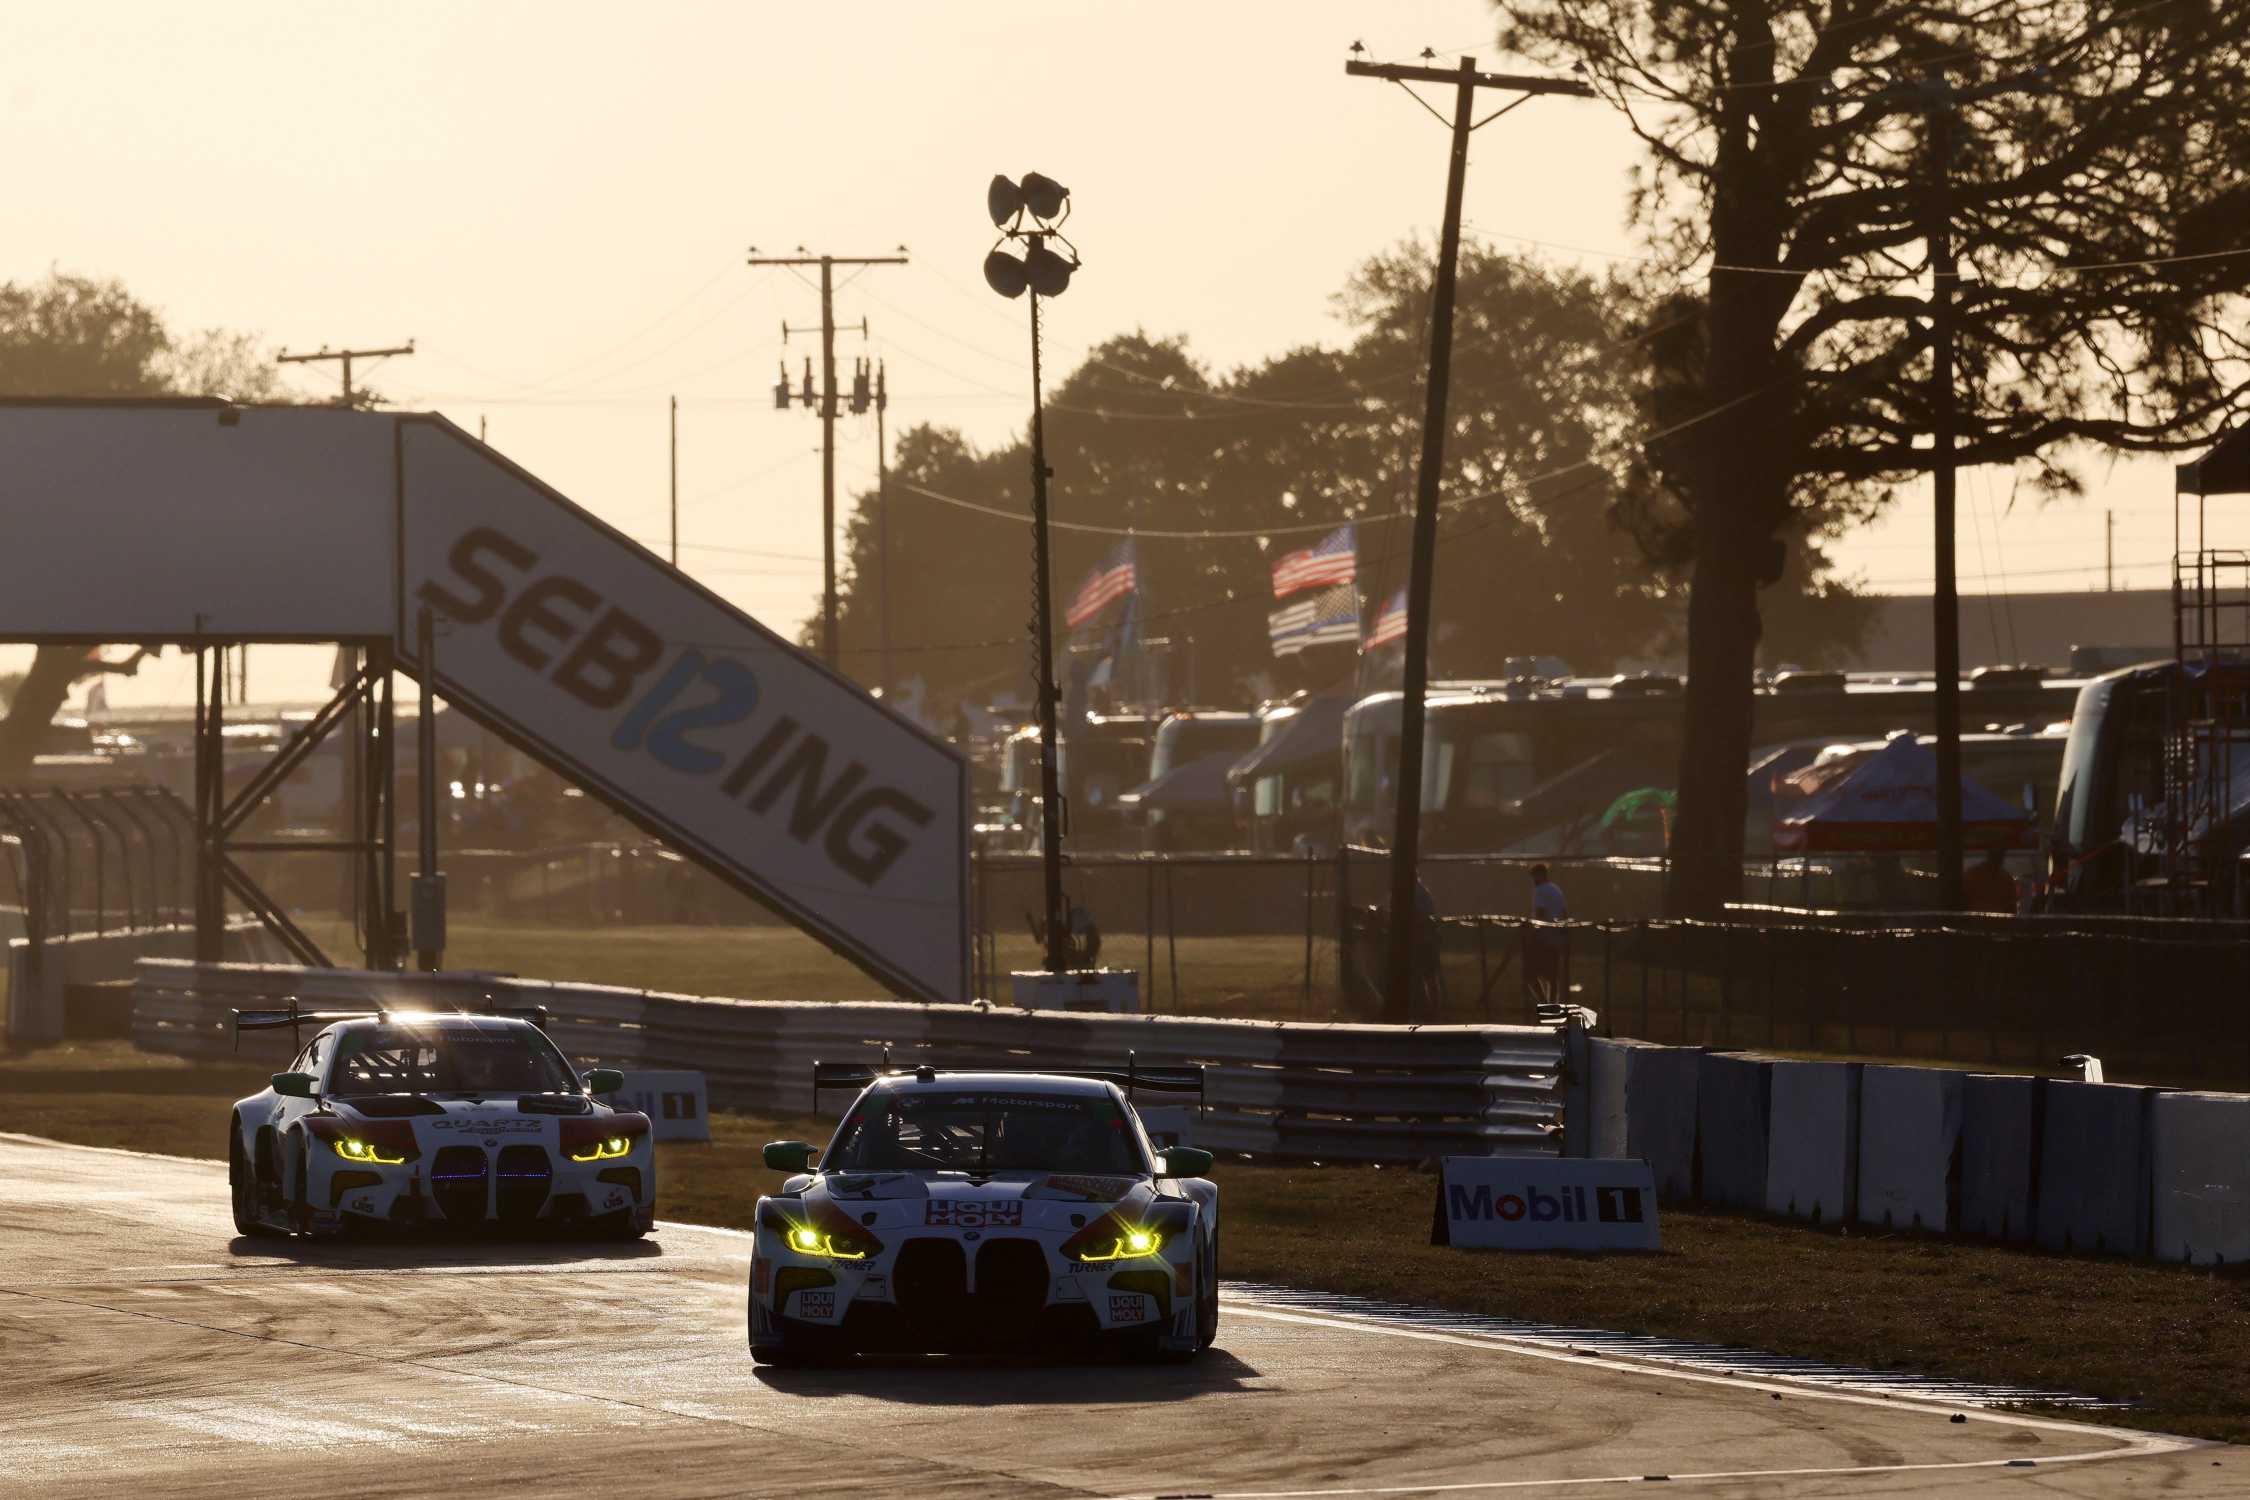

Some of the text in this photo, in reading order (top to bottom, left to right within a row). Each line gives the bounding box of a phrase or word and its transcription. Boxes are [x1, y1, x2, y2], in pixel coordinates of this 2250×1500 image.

[981, 1096, 1081, 1111] Motorsport
[432, 1119, 544, 1129] QUARTZ
[929, 1200, 1019, 1215] LIQUI
[1449, 1184, 1587, 1222] Mobil
[929, 1213, 1018, 1226] MOLY
[1069, 1261, 1116, 1273] TURNER
[801, 1291, 834, 1305] LIQUI
[1111, 1295, 1145, 1309] LIQUI
[801, 1304, 833, 1317] MOLY
[1111, 1308, 1144, 1321] MOLY
